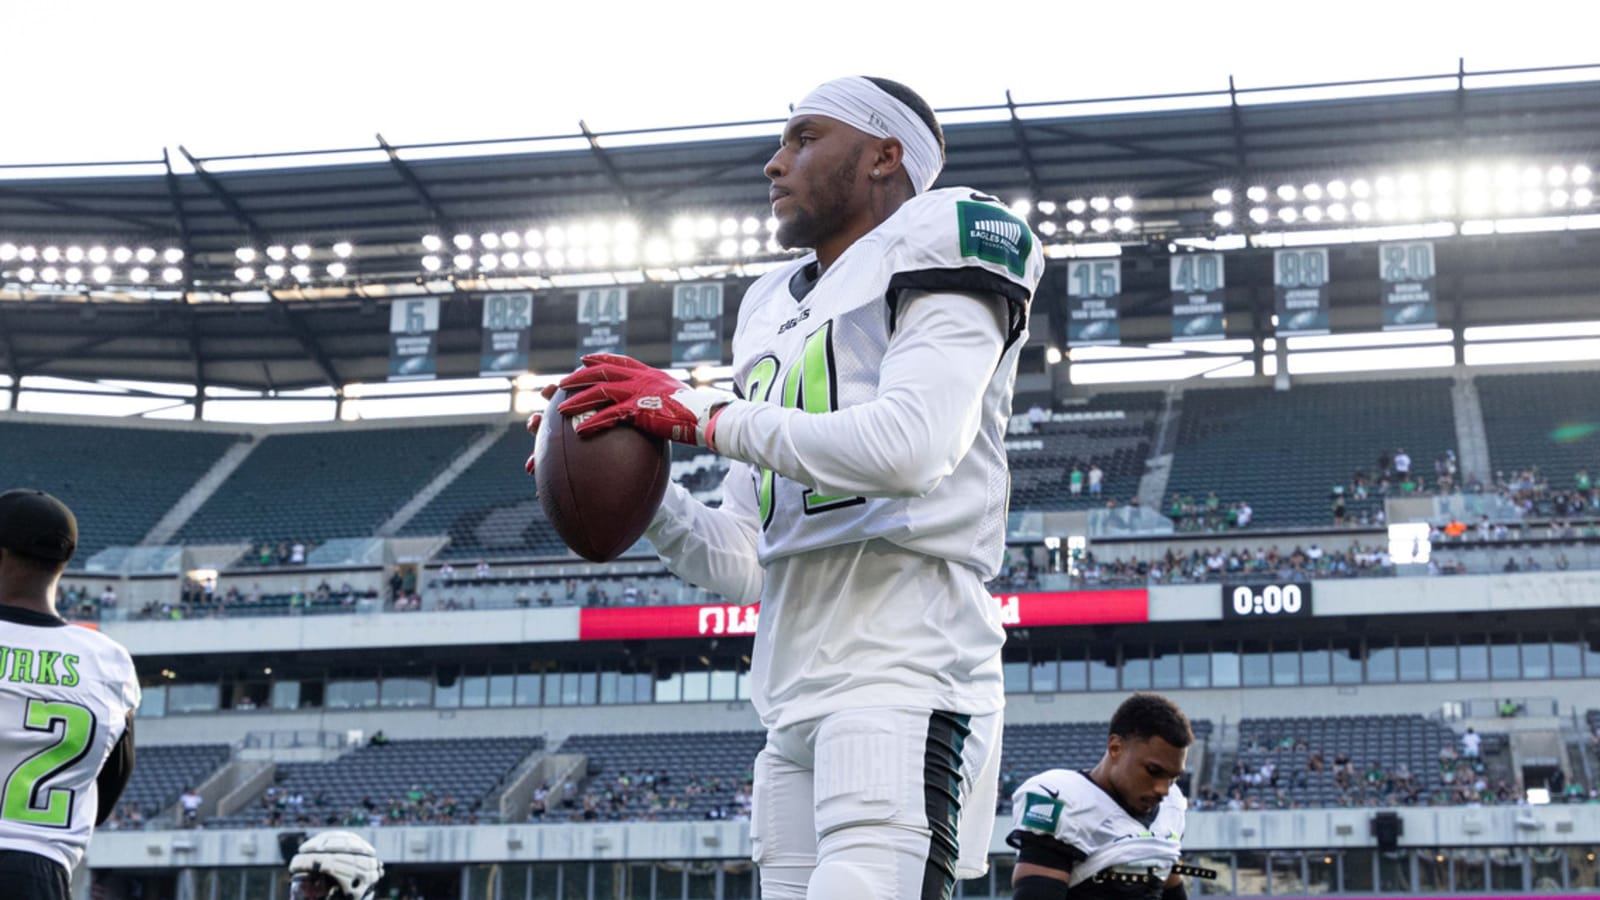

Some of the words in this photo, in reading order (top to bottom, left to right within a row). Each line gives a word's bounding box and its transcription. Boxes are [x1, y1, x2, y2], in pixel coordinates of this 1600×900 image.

[970, 230, 1000, 243] EAGLES
[1072, 263, 1116, 298] 15
[1176, 256, 1218, 292] 40
[583, 289, 622, 325] 44
[1233, 585, 1302, 615] 0:00
[0, 697, 97, 829] 2
